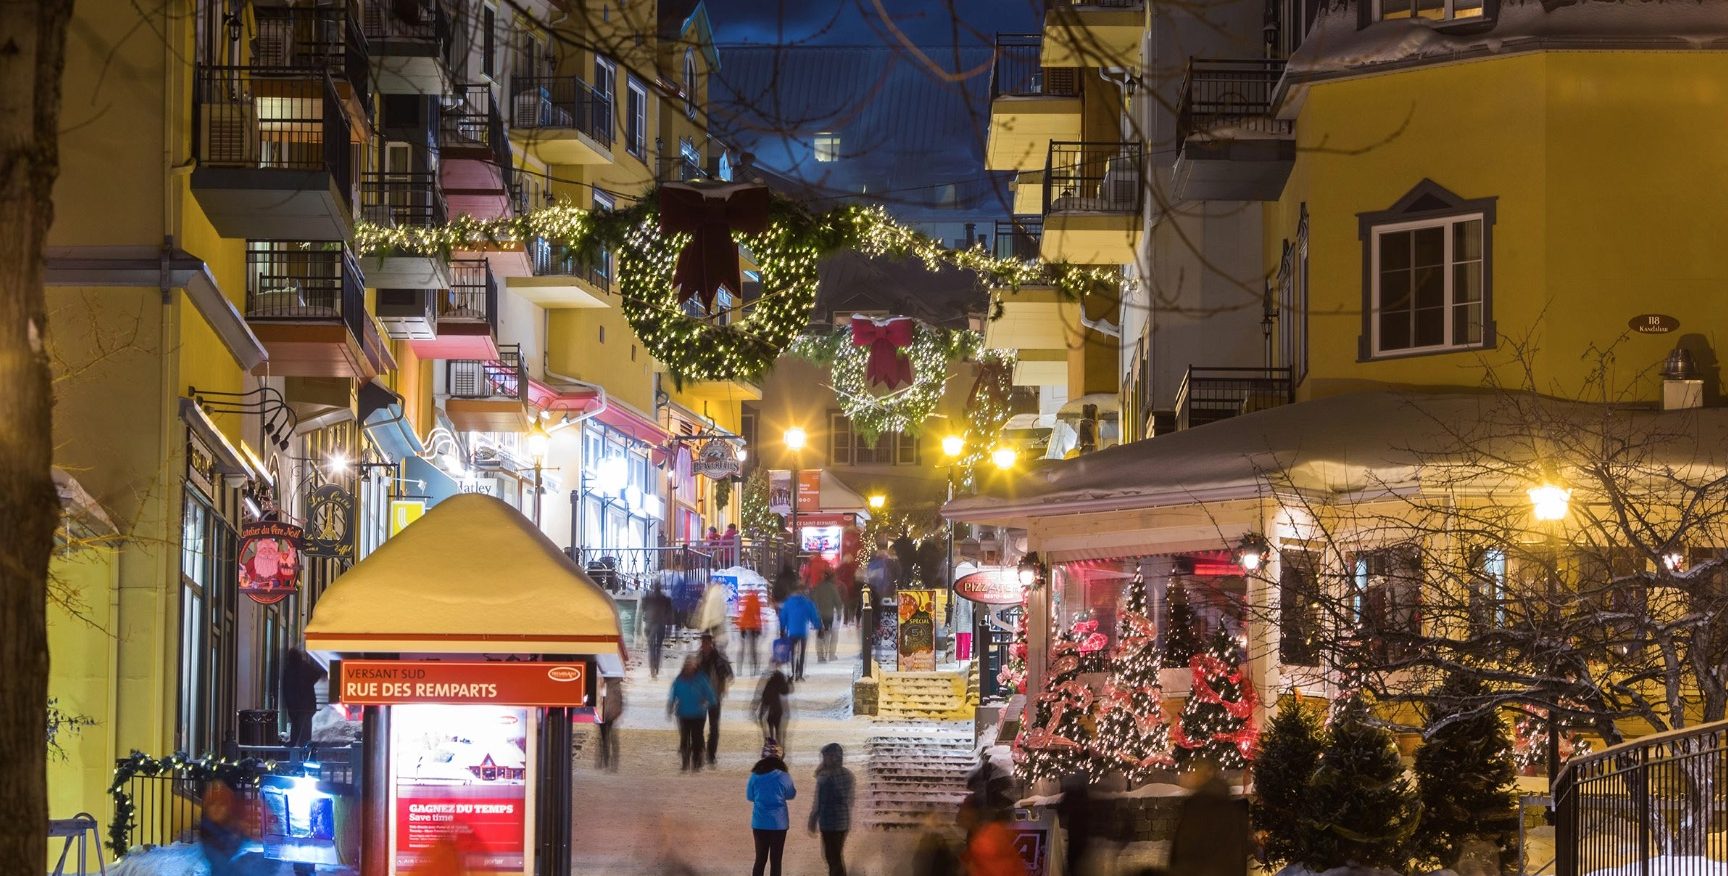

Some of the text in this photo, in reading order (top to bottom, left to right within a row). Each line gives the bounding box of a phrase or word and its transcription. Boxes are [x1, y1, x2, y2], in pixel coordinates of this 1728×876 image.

[1649, 316, 1660, 325] 118
[347, 669, 426, 679] VERSANT SUD
[346, 682, 498, 698] RUE DES REMPARTS
[408, 804, 514, 813] GAGNEZ DU TEMPS
